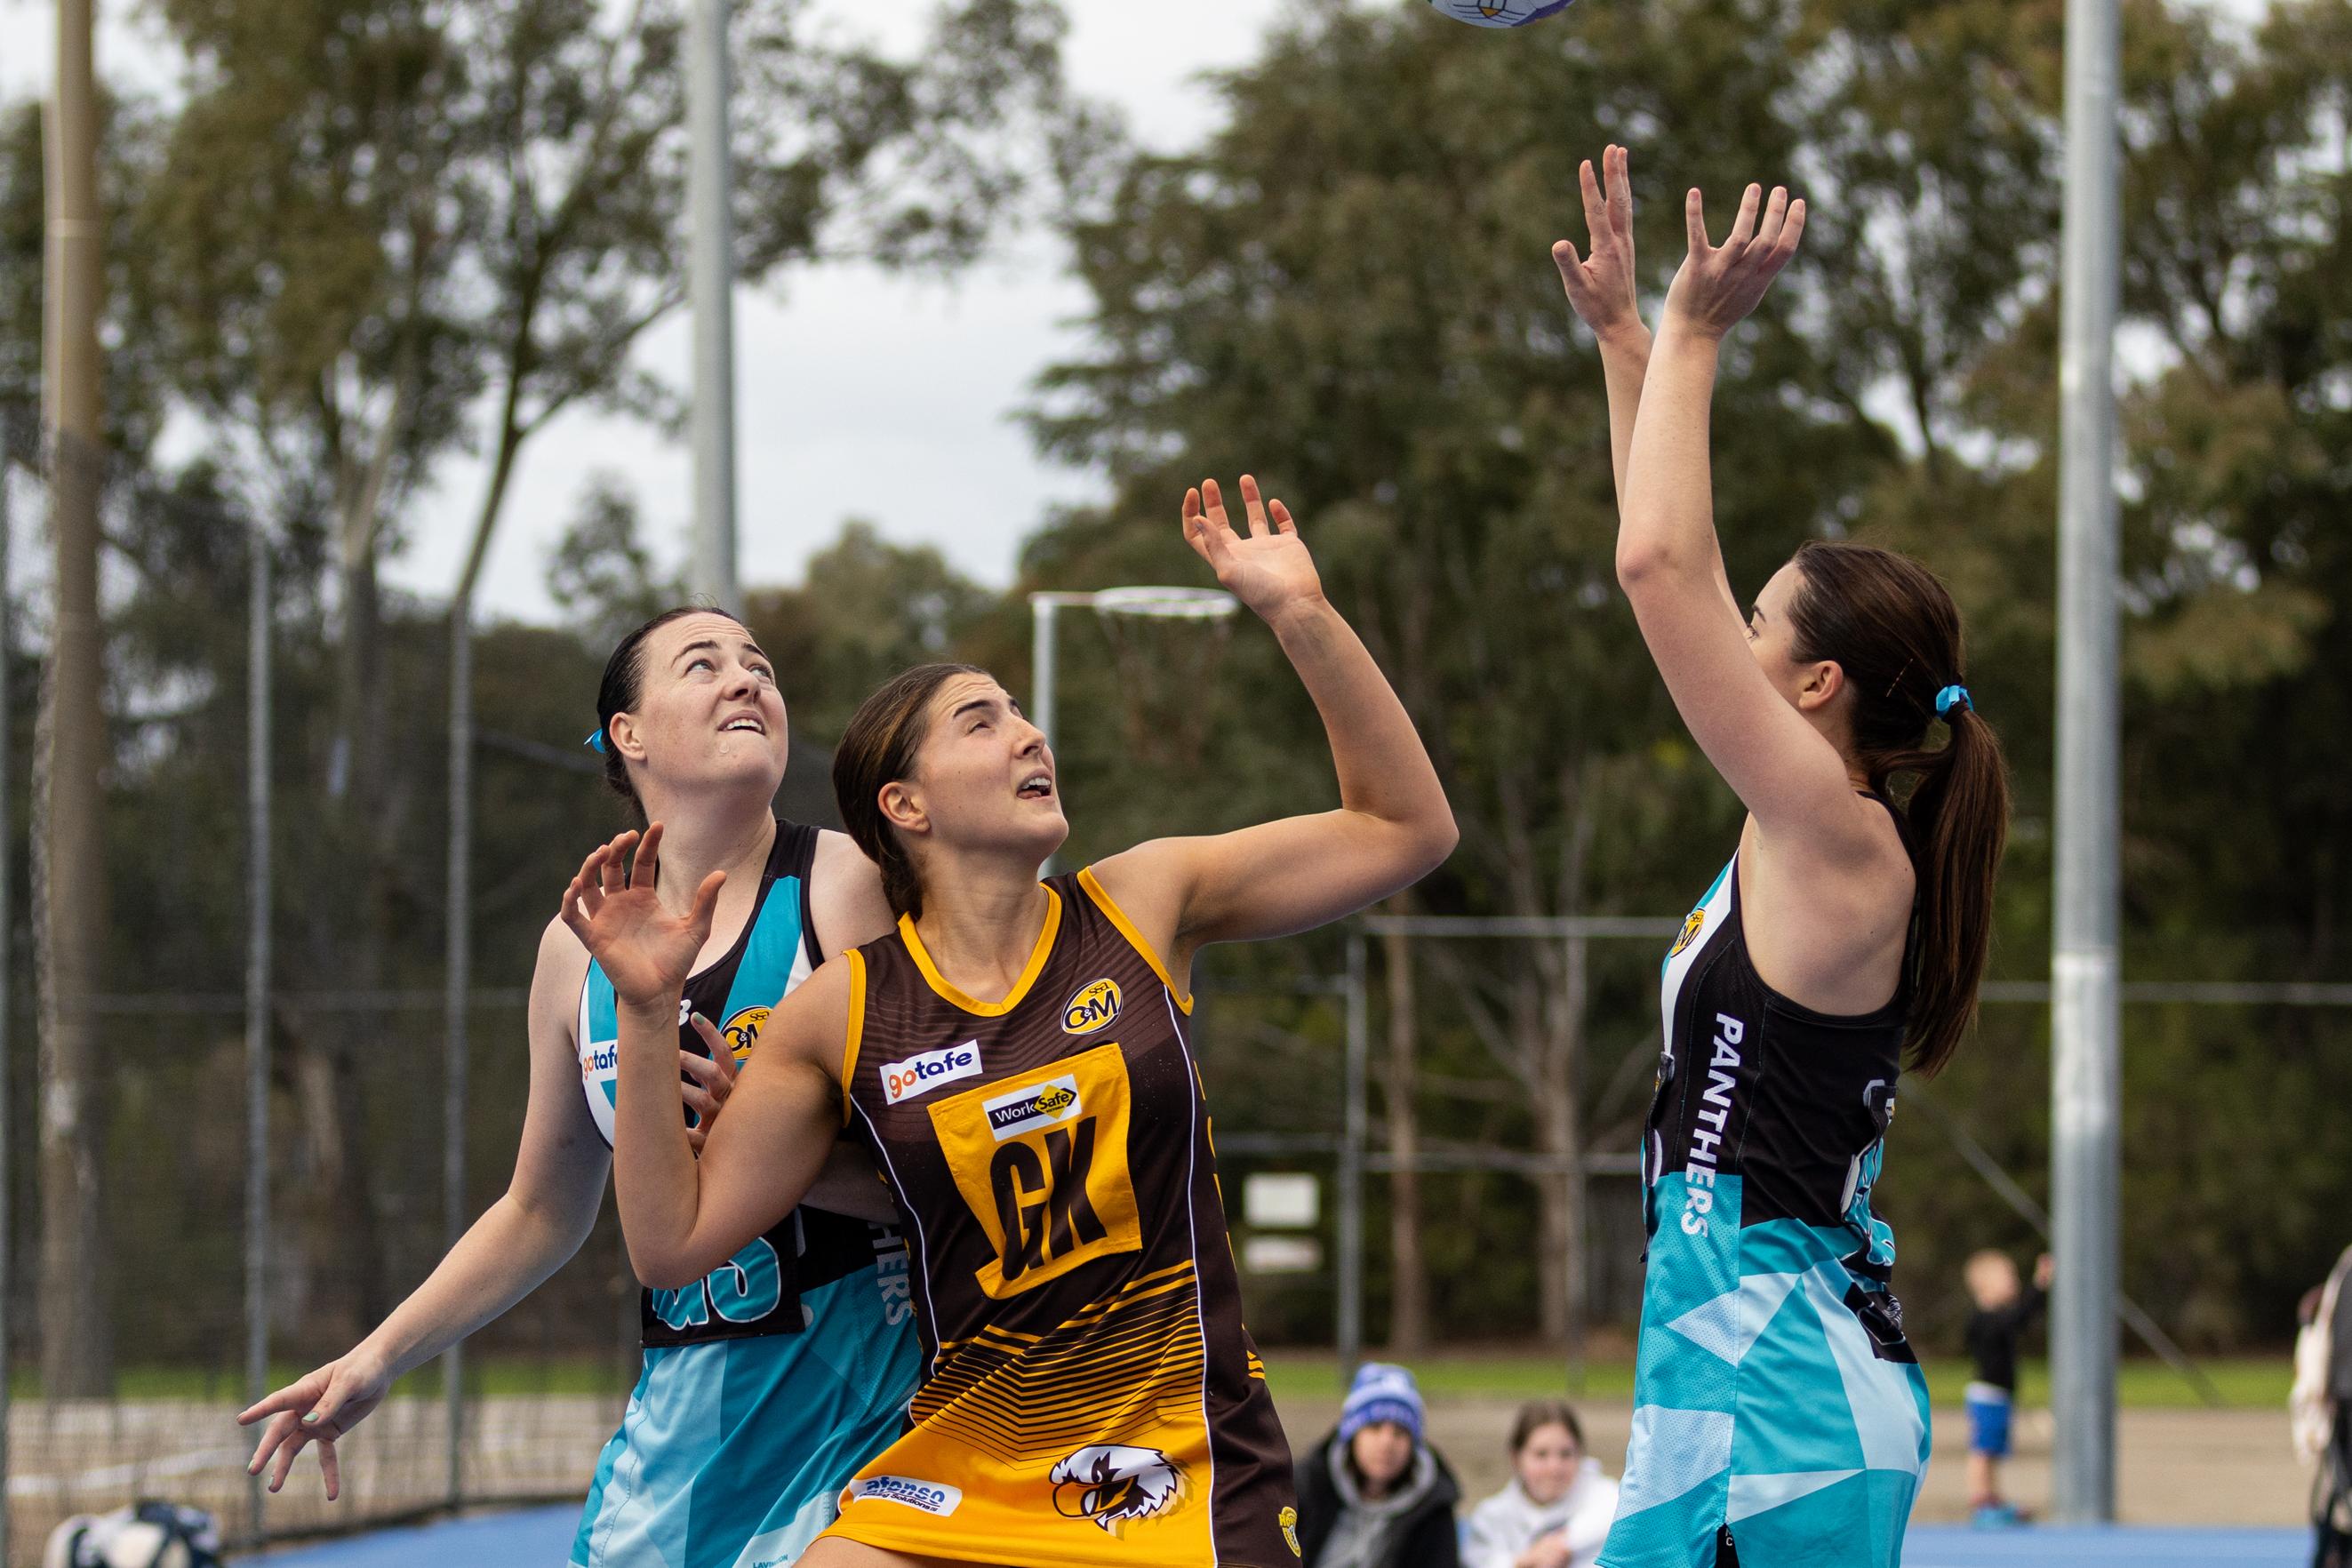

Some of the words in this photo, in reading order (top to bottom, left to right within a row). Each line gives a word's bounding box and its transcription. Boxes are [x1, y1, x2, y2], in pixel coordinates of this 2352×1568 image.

[583, 1044, 618, 1080] gotaf
[889, 1052, 973, 1099] gotafe
[1681, 1012, 1744, 1237] PANTHERS
[990, 1116, 1108, 1281] GK
[890, 1493, 931, 1510] Solutions
